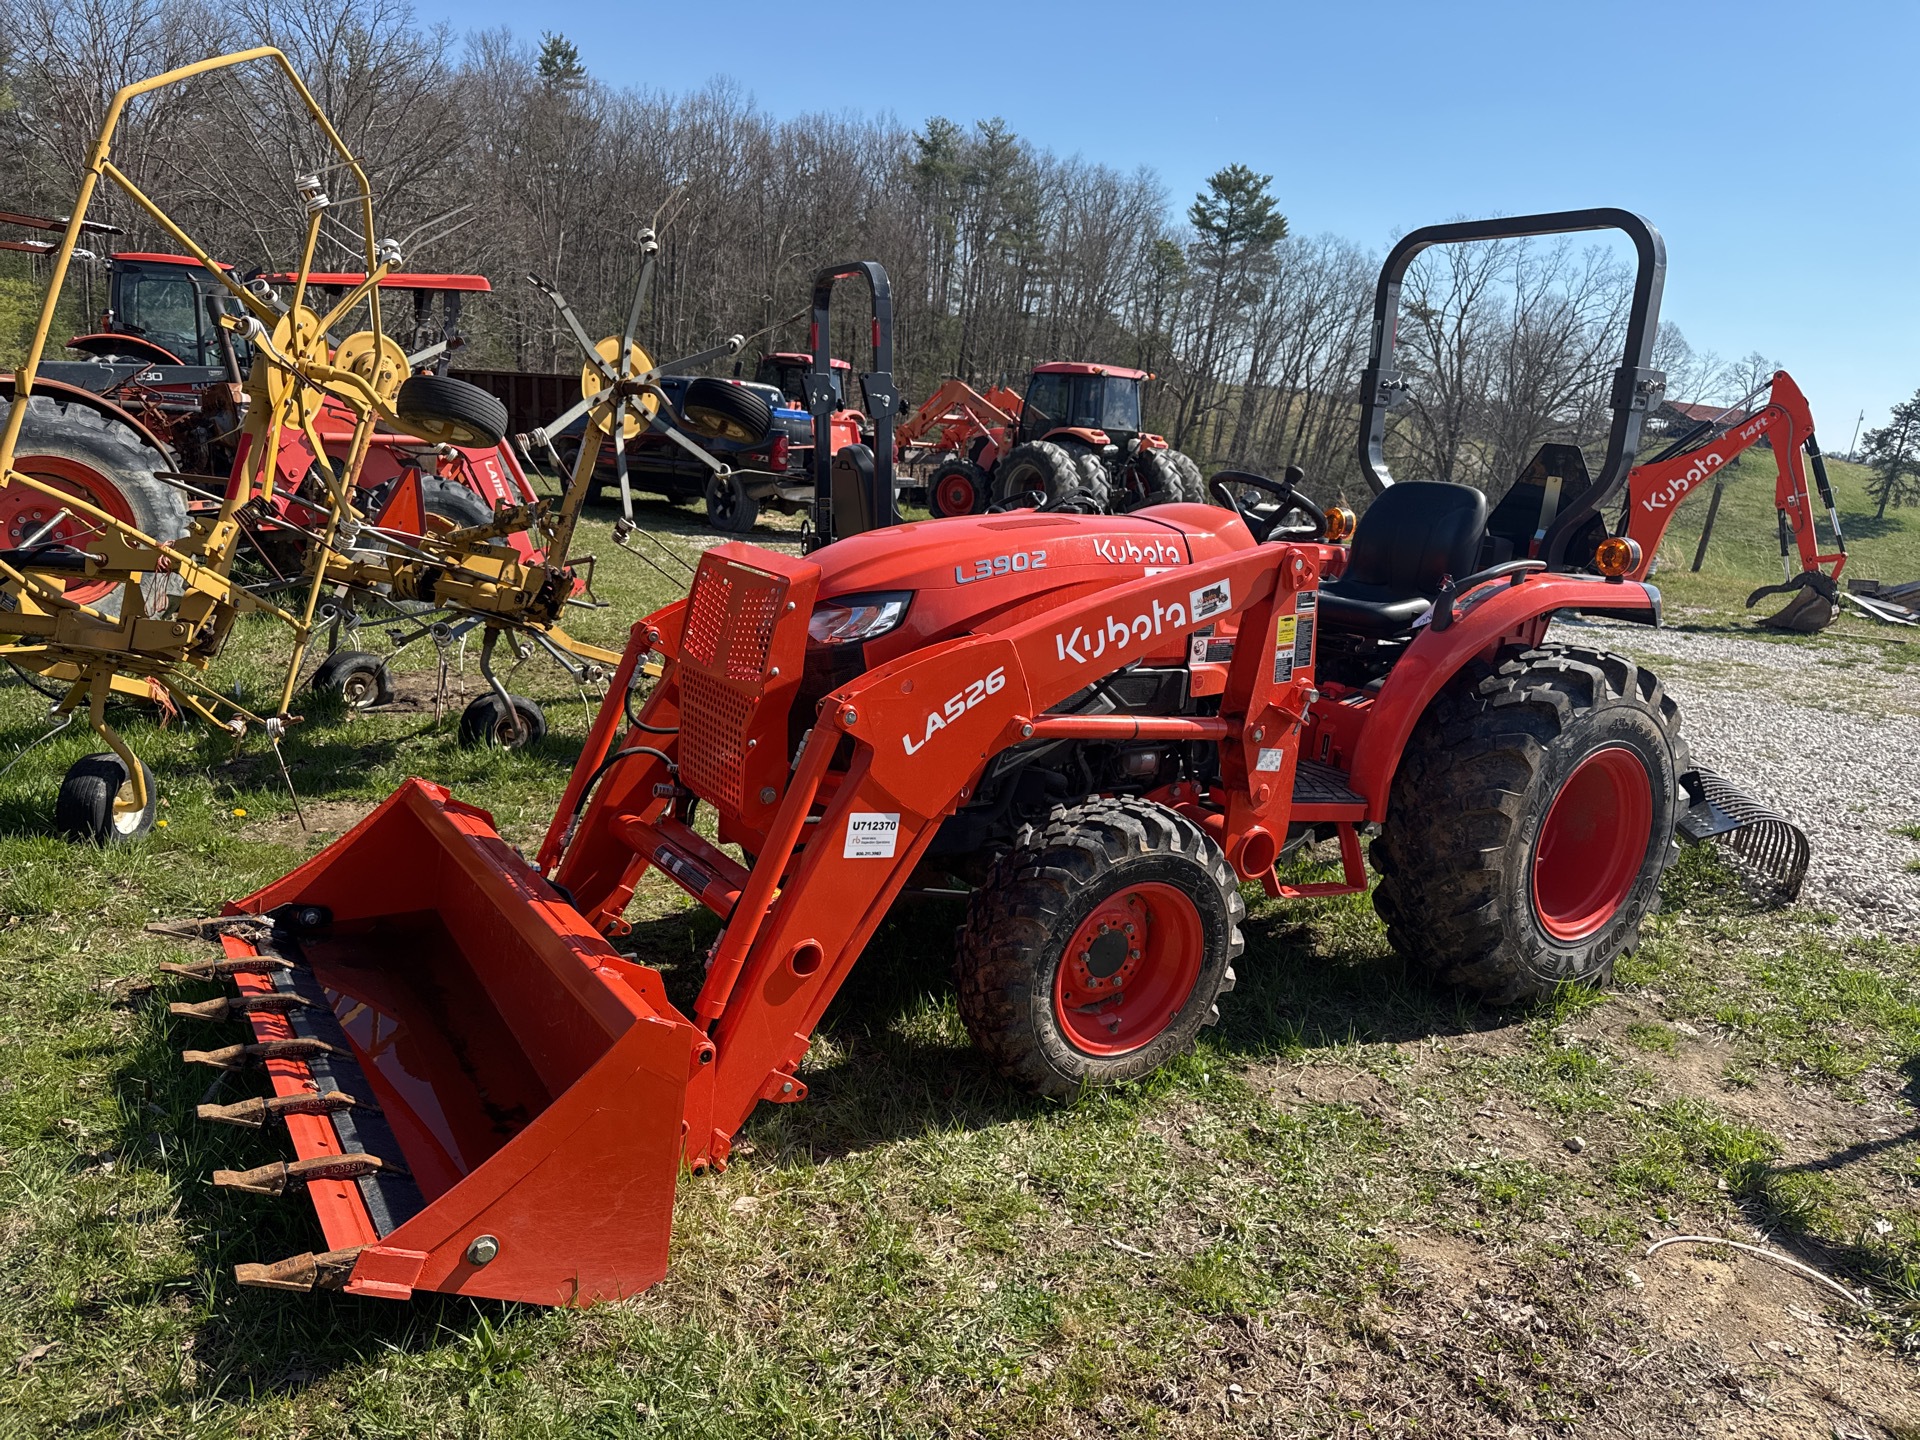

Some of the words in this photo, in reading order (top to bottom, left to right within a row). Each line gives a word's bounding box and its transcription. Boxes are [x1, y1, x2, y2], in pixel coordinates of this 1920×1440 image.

[1740, 417, 1769, 440] 14ft
[1642, 453, 1724, 512] Kubota
[955, 550, 1047, 584] L3902
[1093, 538, 1181, 564] Kubota
[1056, 599, 1186, 664] Kubota
[902, 665, 1006, 756] LA526
[852, 821, 897, 831] U712370
